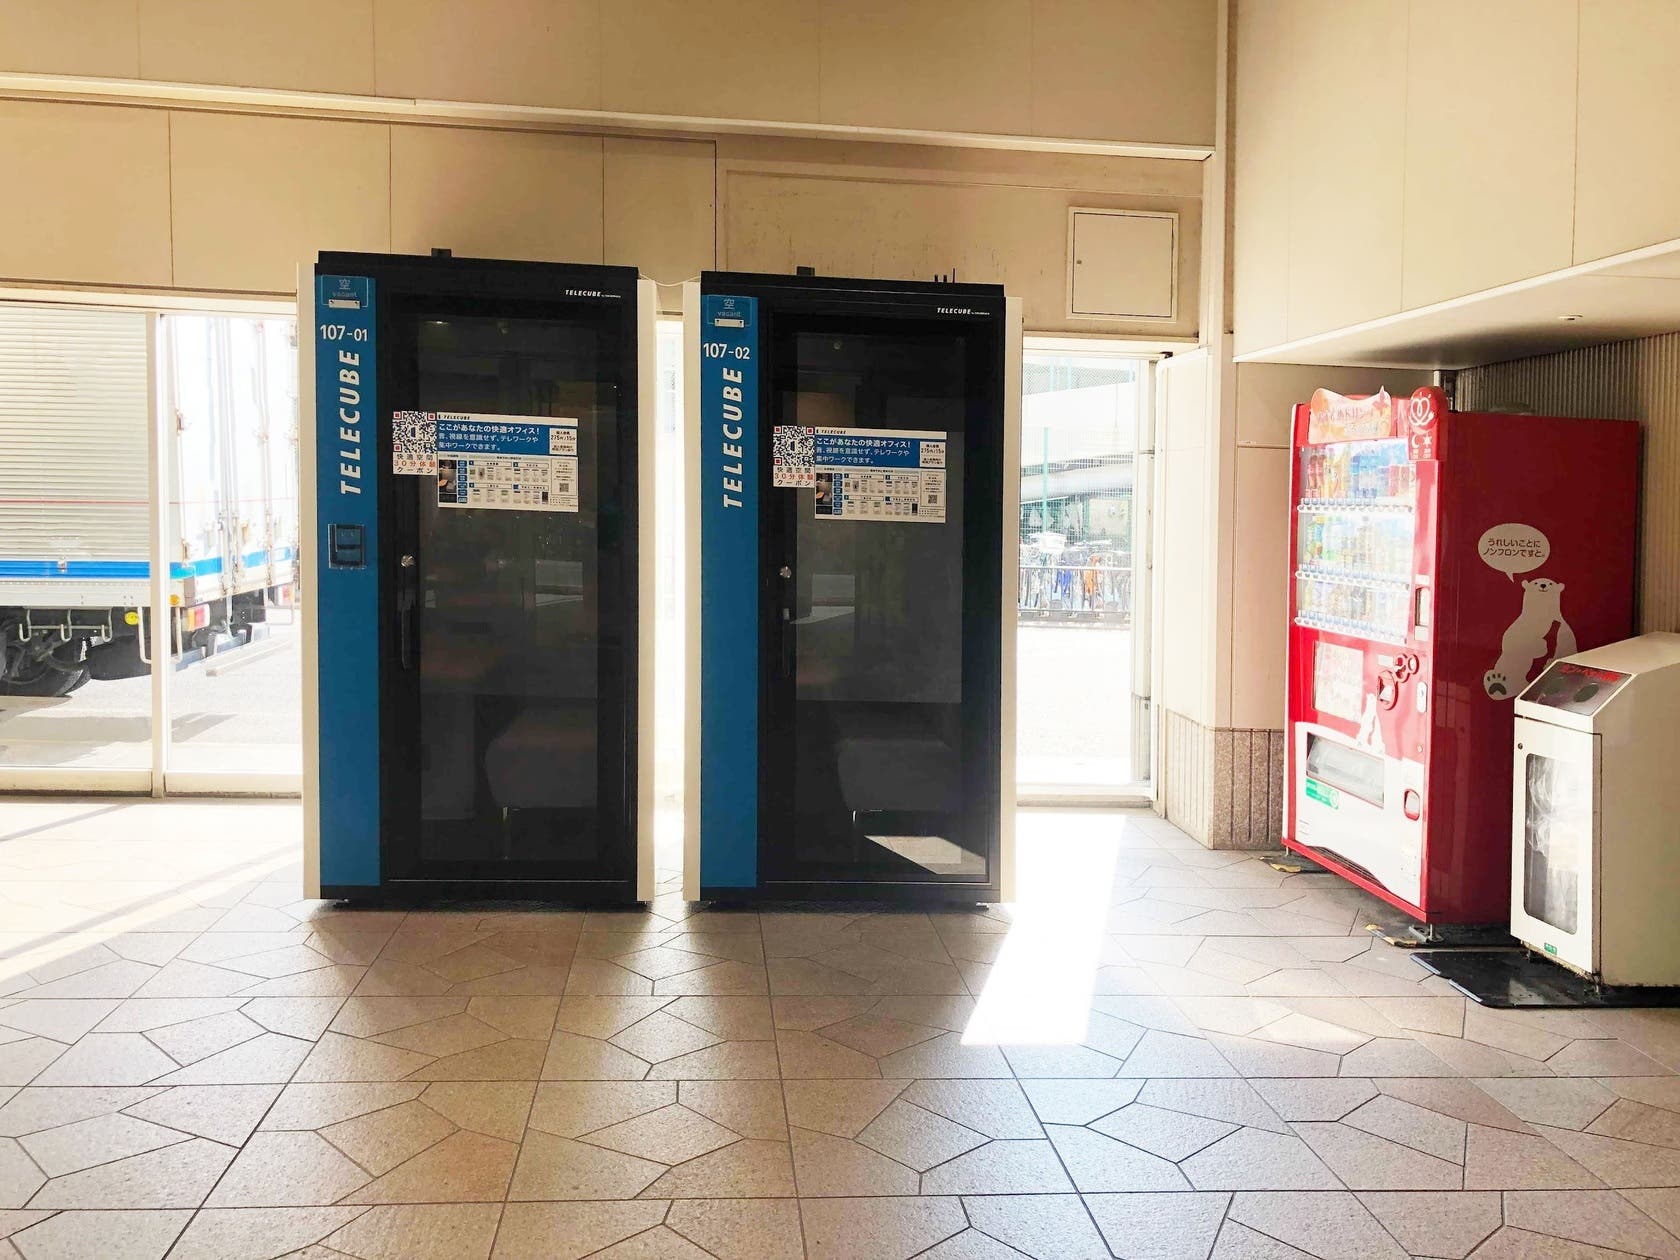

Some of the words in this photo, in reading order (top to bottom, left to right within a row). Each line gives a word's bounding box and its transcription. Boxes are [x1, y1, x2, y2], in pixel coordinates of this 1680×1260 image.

[565, 289, 602, 297] TELECUBE
[723, 298, 735, 310] 空
[937, 307, 972, 315] TELECUBE
[320, 324, 368, 342] 107-01
[703, 343, 750, 360] 107-02
[338, 350, 361, 495] TELECUBE
[722, 367, 743, 508] TELECUBE
[397, 466, 433, 474] クーポン
[777, 479, 811, 487] クーポン
[1487, 537, 1541, 548] うれしいことに
[1483, 547, 1545, 558] ノンフロンですと。
